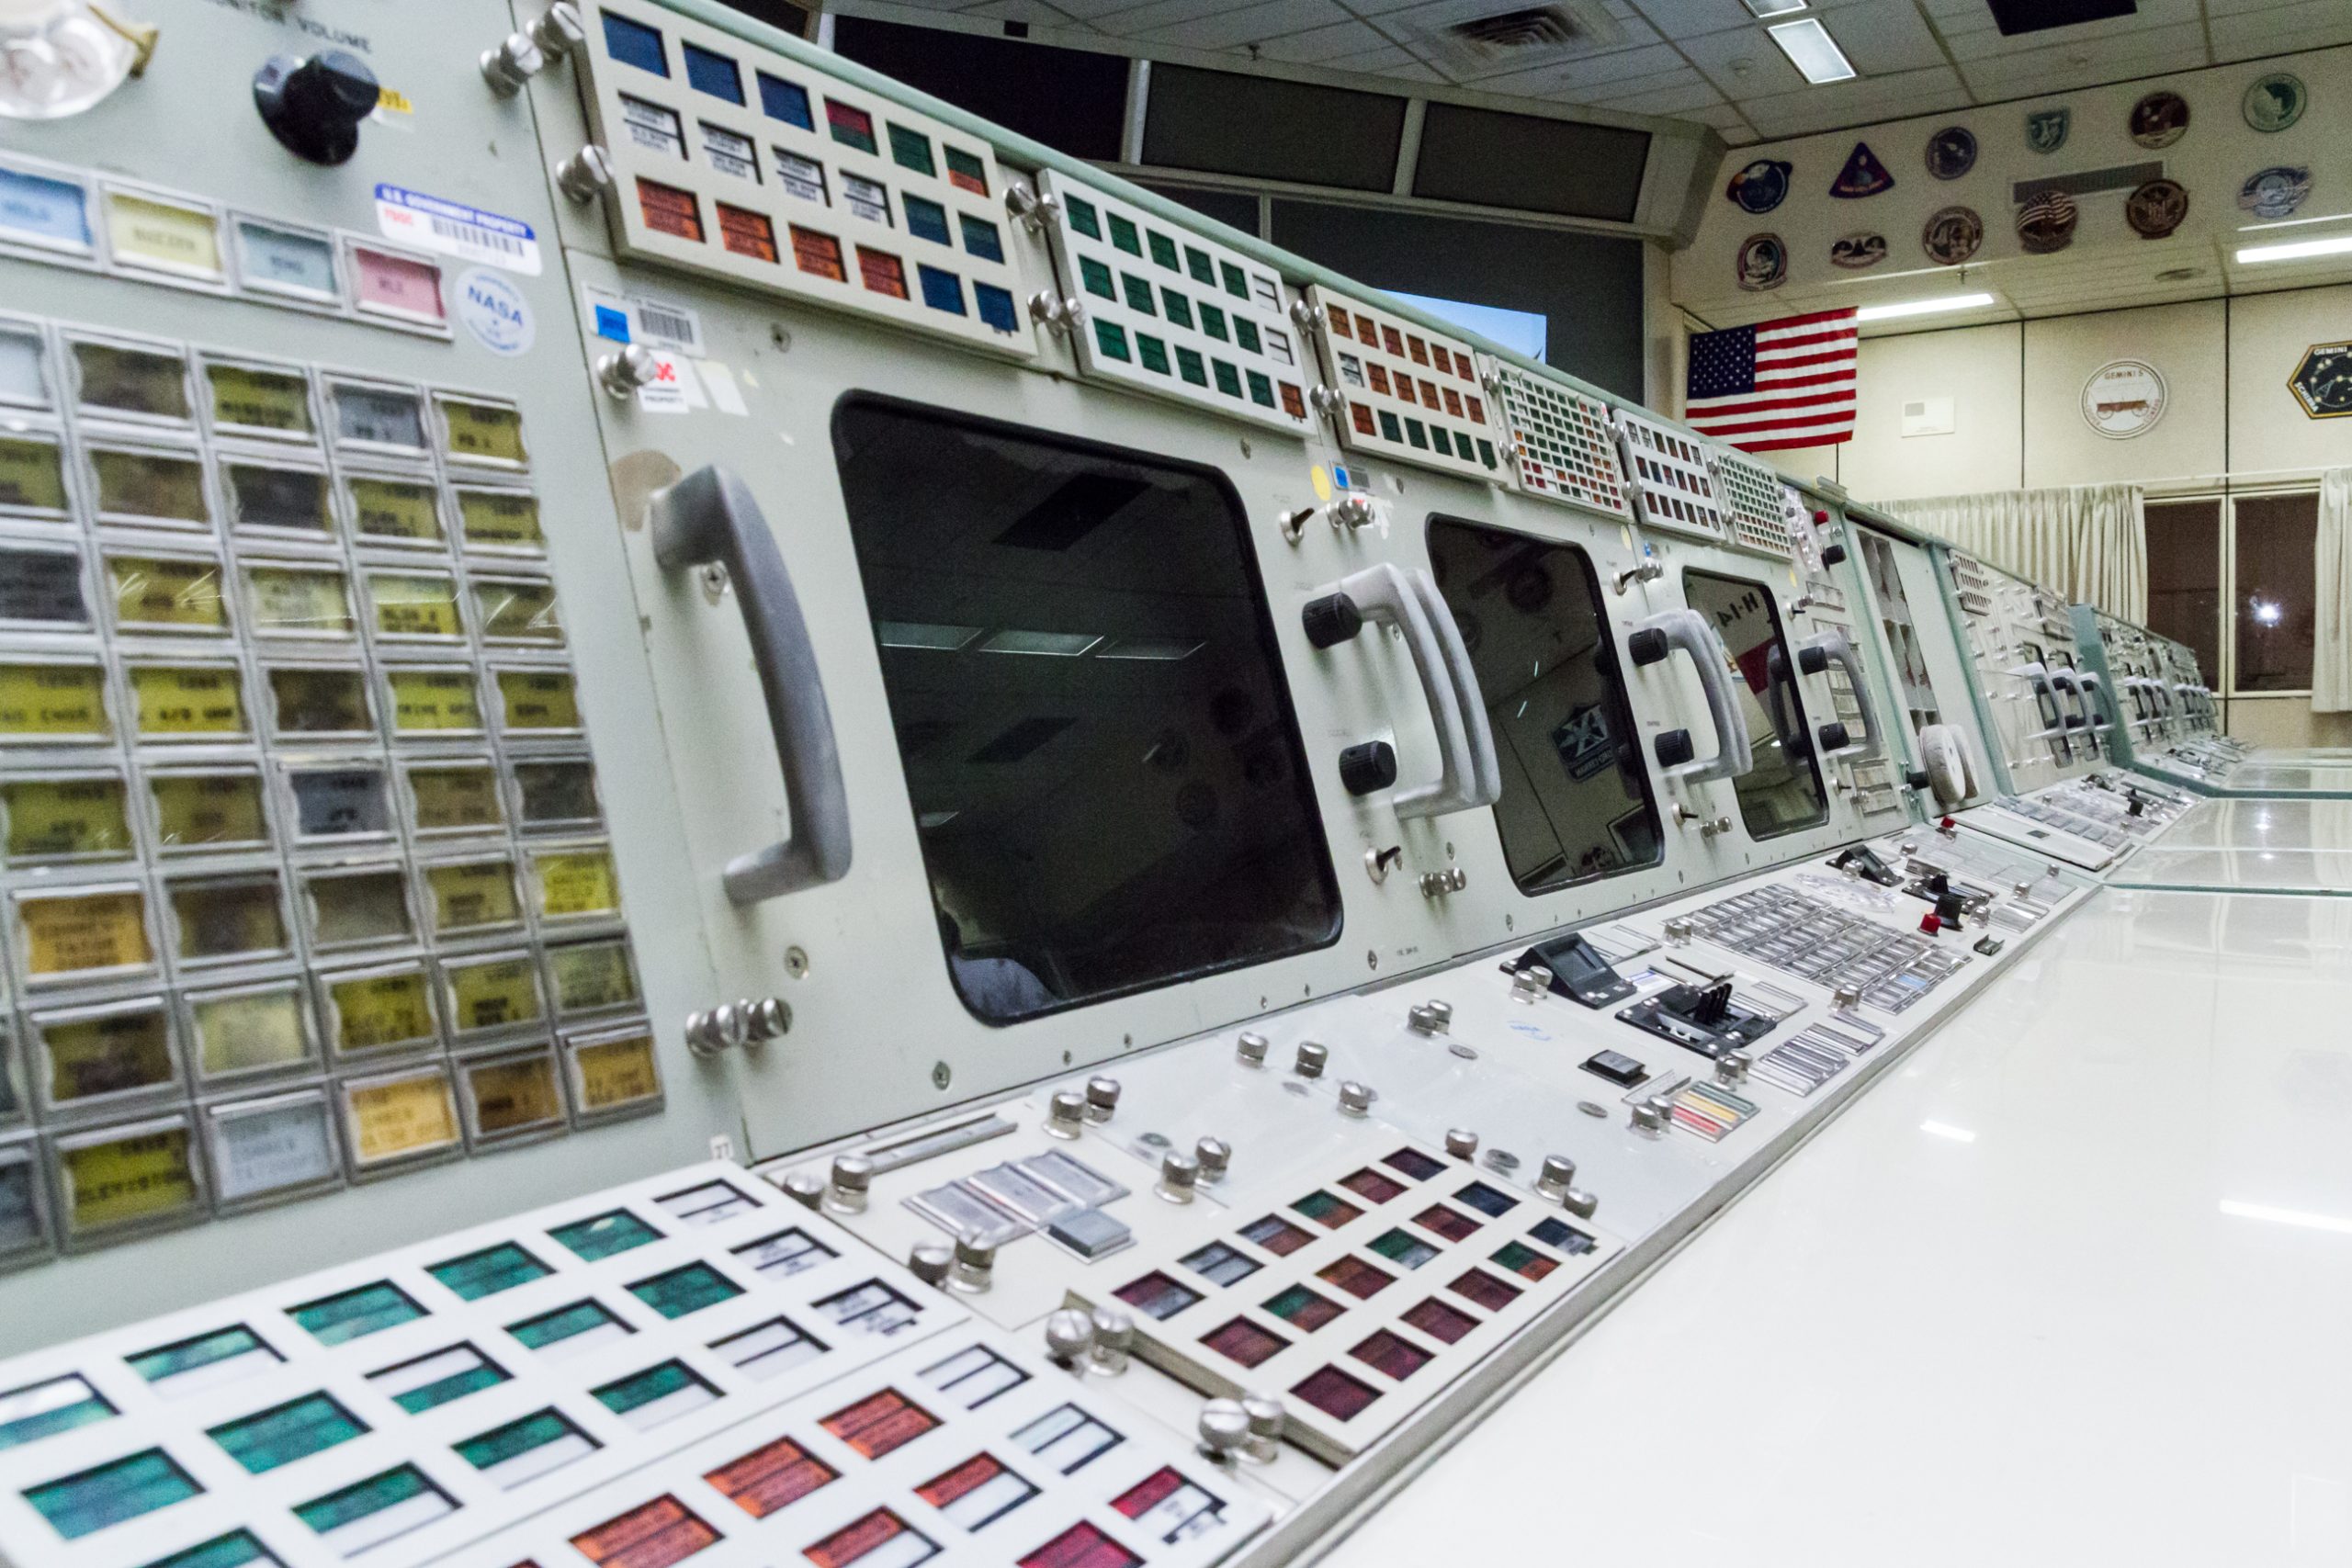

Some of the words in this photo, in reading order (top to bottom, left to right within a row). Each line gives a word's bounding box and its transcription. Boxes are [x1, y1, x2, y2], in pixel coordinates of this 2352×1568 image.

[297, 16, 371, 53] VOLUME
[467, 285, 523, 328] NASA
[2314, 346, 2347, 355] GEMINI
[2105, 370, 2136, 380] GEMINI
